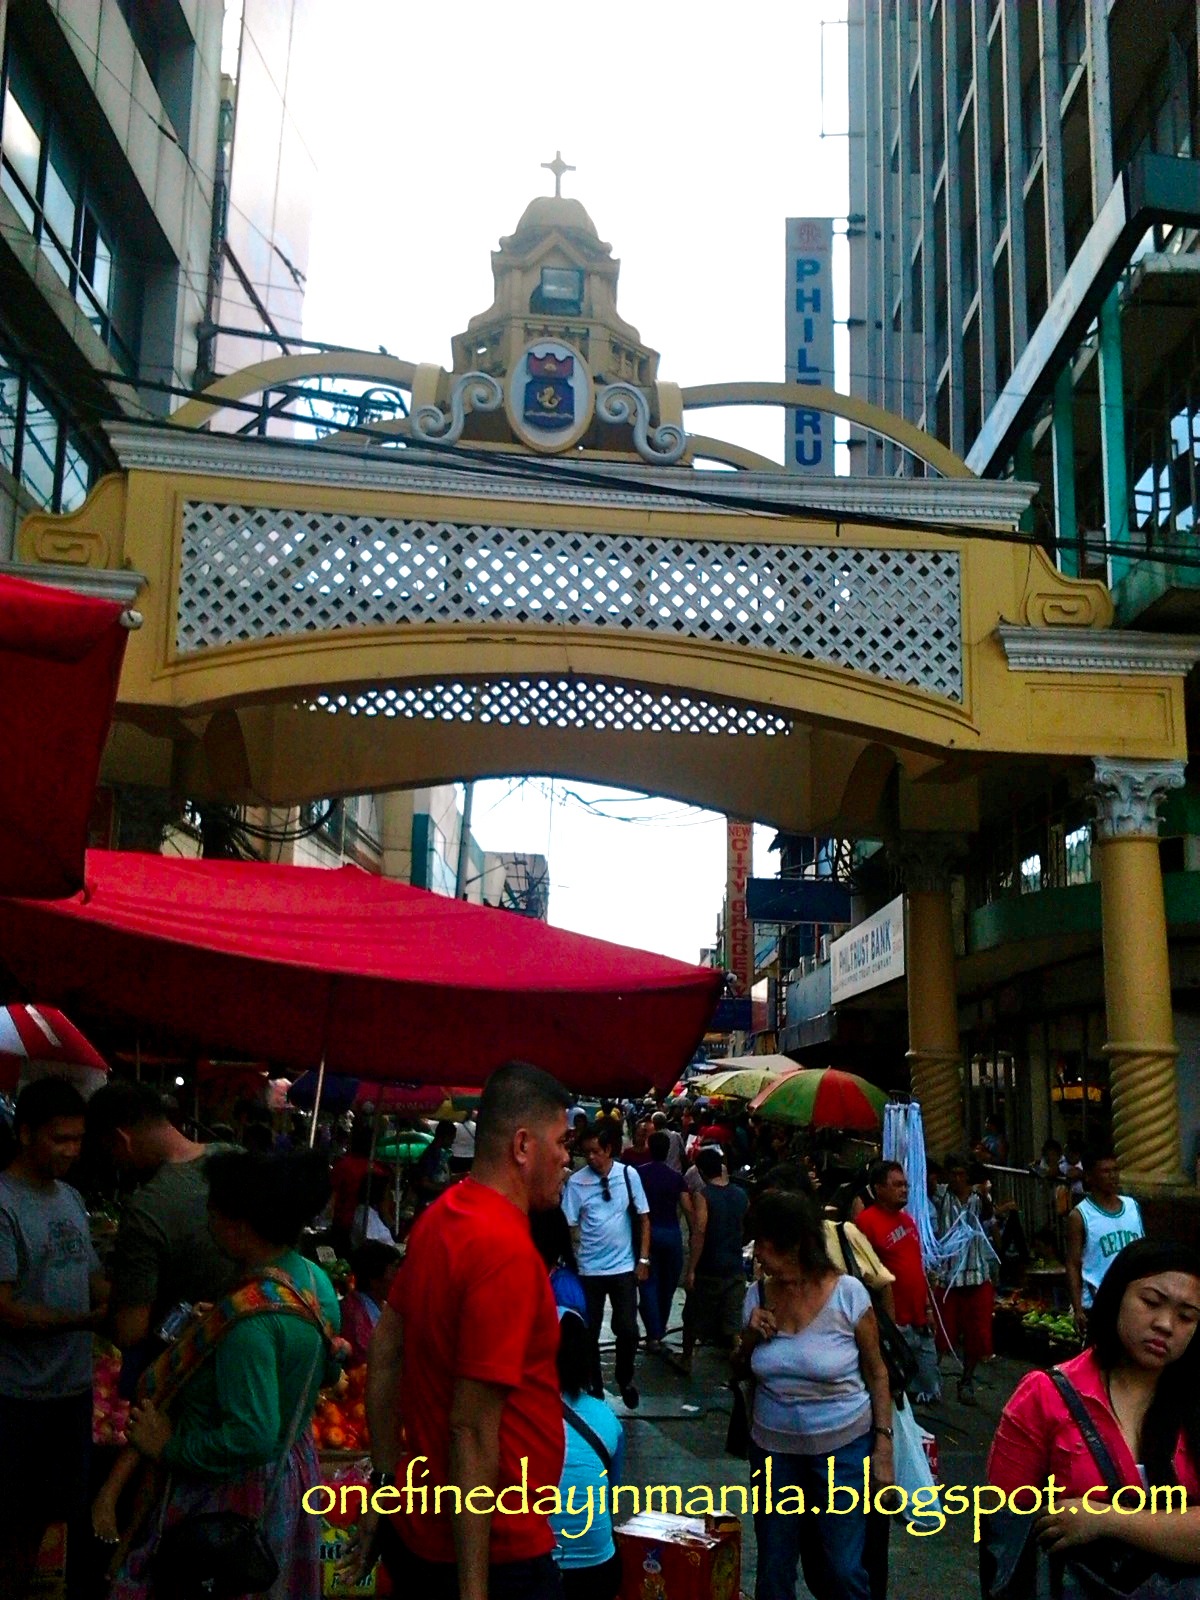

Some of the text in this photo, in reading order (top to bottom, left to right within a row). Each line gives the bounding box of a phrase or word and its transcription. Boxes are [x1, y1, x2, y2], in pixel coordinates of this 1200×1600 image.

[796, 258, 821, 466] PHILRU
[731, 838, 748, 893] CITY
[871, 918, 892, 960] BANK
